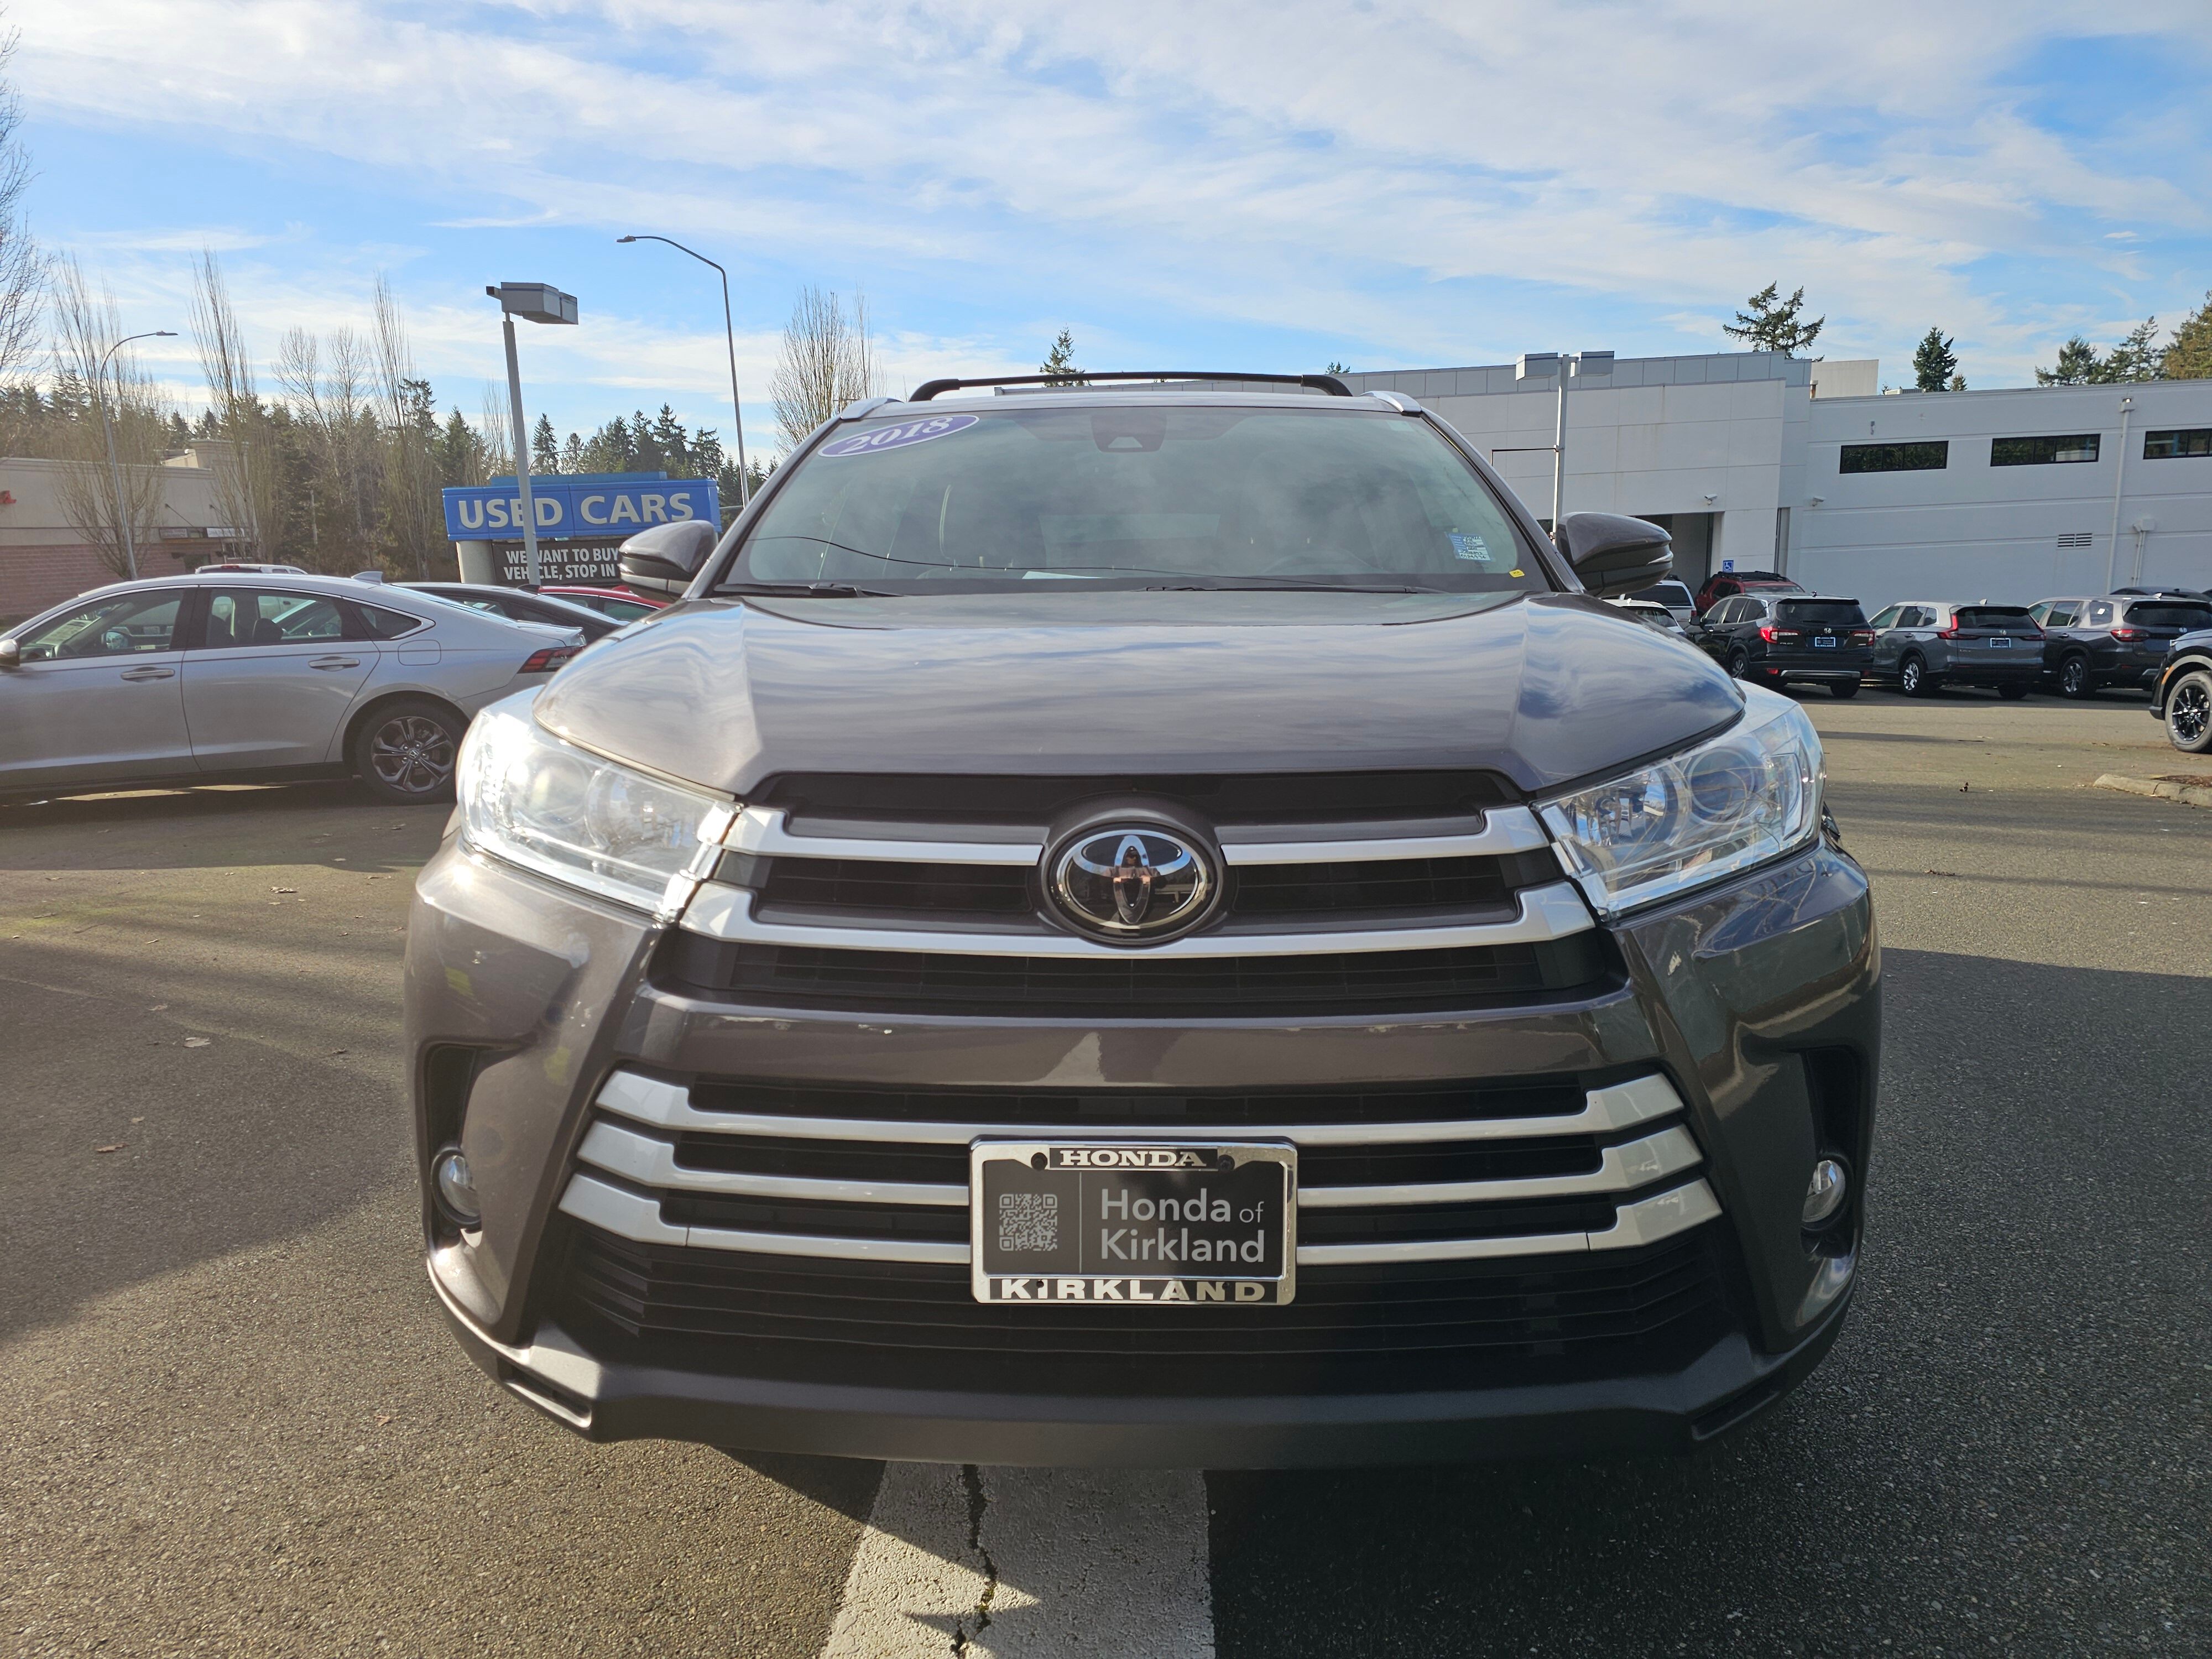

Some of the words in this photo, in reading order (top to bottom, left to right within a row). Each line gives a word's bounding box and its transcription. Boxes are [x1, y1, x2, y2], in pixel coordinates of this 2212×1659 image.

[838, 416, 954, 455] 2018
[458, 497, 563, 529] USED
[581, 493, 694, 524] CARS
[505, 550, 528, 564] WE
[572, 548, 589, 562] TO
[593, 547, 618, 562] BUY
[503, 565, 562, 580] VEHCLE,
[565, 564, 598, 578] STOP
[601, 564, 615, 577] IN
[1060, 1150, 1207, 1167] HONDA
[1101, 1188, 1231, 1222] Honda
[1239, 1201, 1265, 1223] of
[1101, 1228, 1265, 1262] Kirkland
[1001, 1279, 1265, 1302] KIRKLAND
